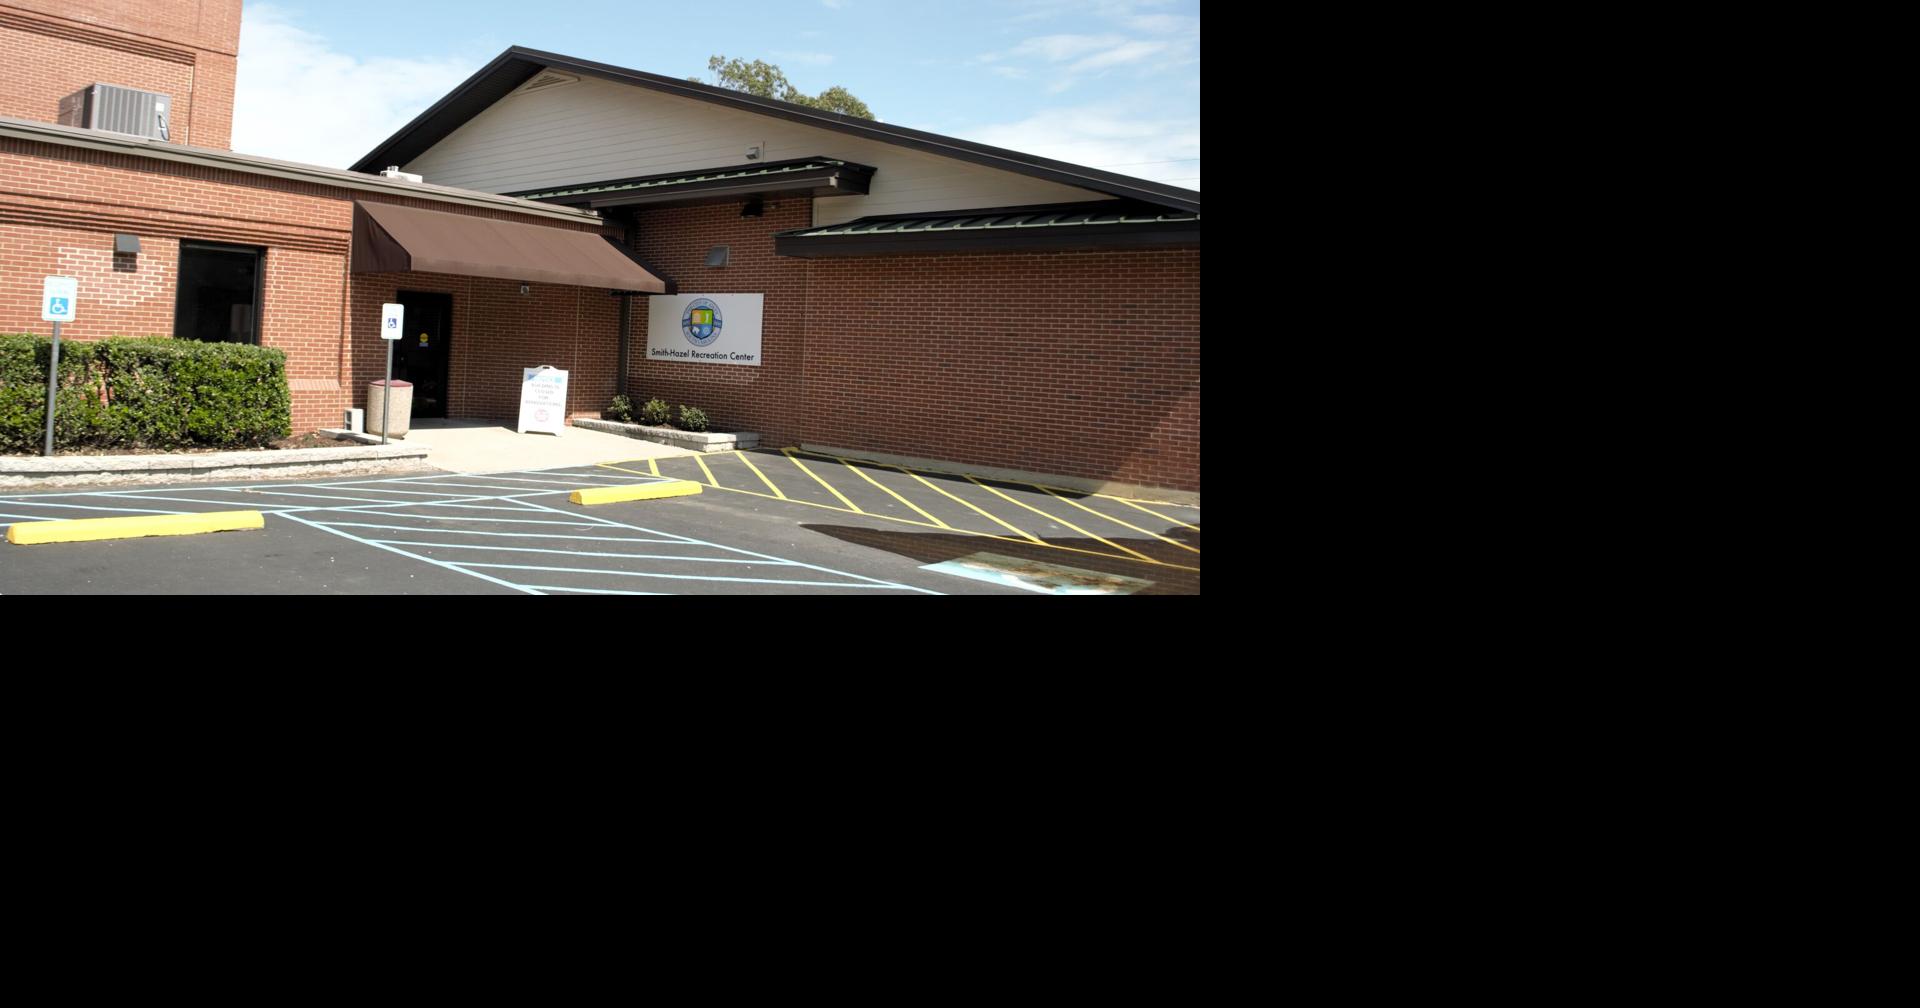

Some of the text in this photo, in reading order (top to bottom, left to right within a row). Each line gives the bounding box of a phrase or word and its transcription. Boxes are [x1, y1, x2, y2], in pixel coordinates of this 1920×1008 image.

[651, 348, 754, 361] Smith-Hazel Recreation Center
